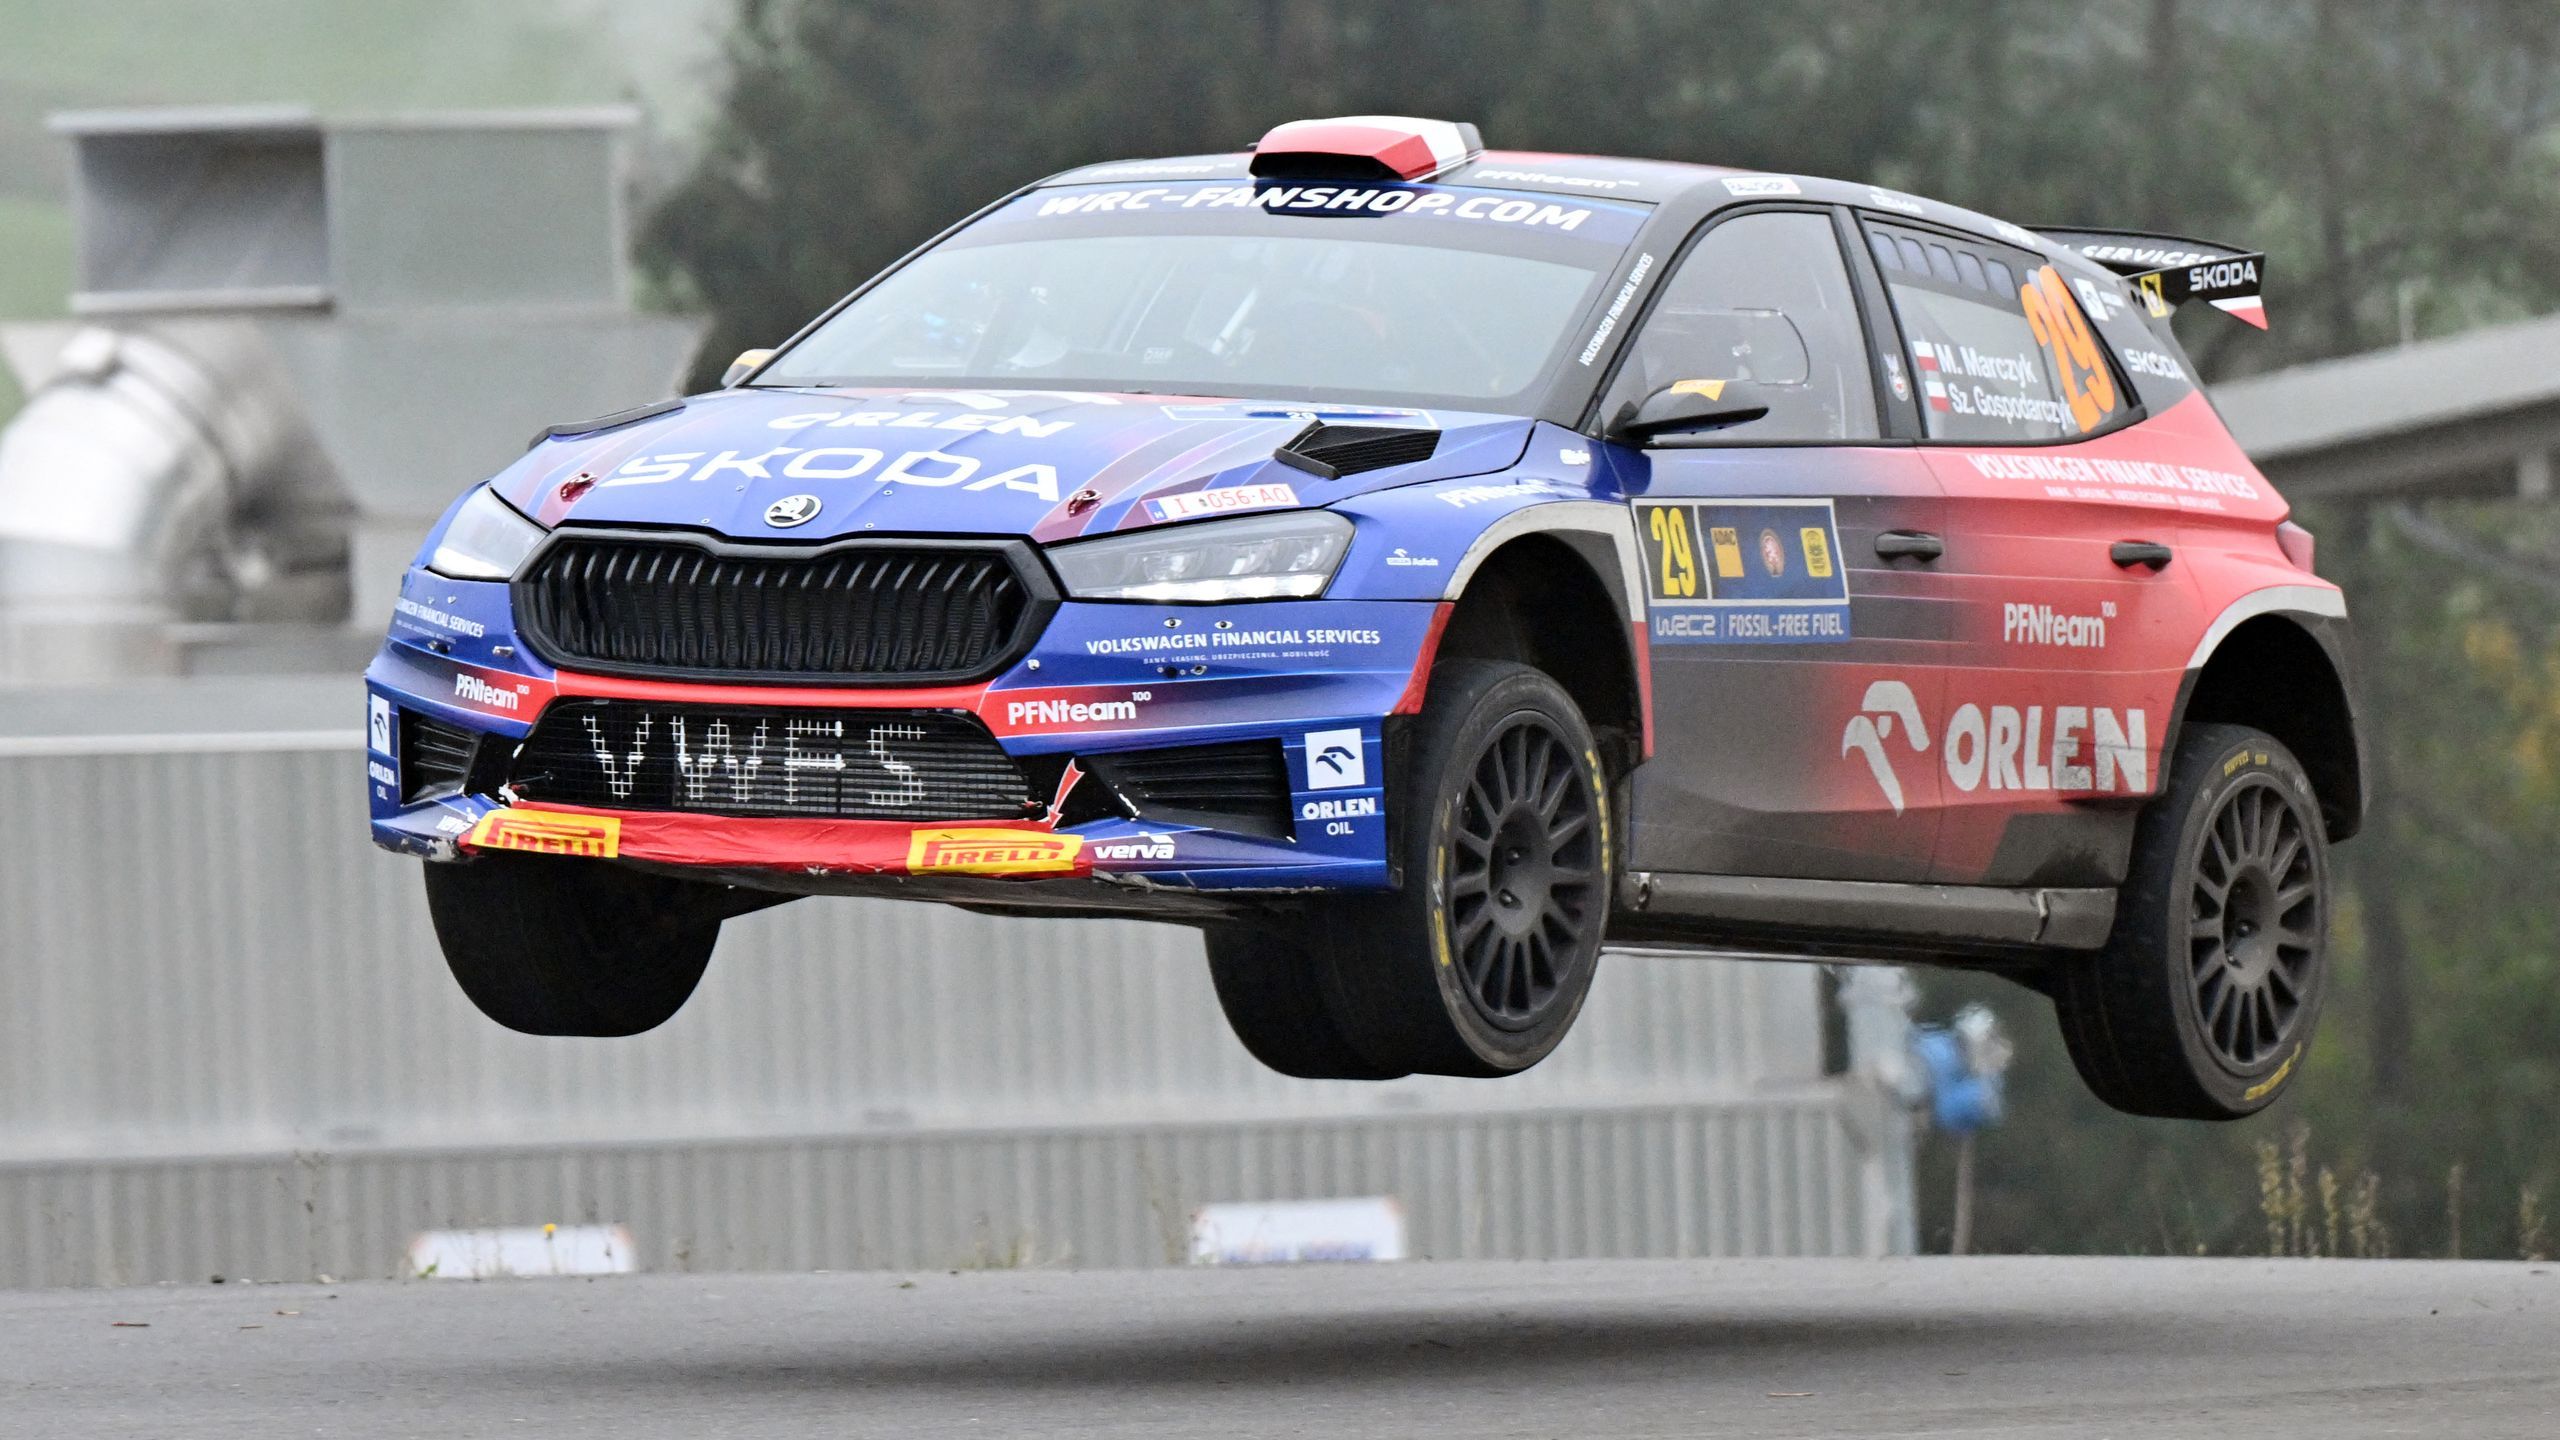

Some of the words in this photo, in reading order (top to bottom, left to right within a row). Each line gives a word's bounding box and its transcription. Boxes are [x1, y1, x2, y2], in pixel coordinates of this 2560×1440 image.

[1036, 186, 1592, 231] WRC-FANSHOP.COM
[2021, 265, 2116, 433] 29
[1934, 344, 1962, 375] M.
[1959, 346, 2038, 388] Marczyk
[1947, 383, 1976, 415] Sz.
[1973, 385, 2077, 431] Gospodarczyk
[767, 411, 1077, 439] ORLEN
[1966, 453, 2100, 483] VOLKSWAGEN
[2097, 458, 2189, 490] FINANCIAL
[2180, 465, 2260, 501] SERVICES
[1650, 506, 1697, 597] 29
[448, 615, 485, 638] SERVICES
[1728, 613, 1810, 637] FOSSIL-FREE
[1812, 613, 1845, 636] FUEL
[2003, 602, 2106, 648] PFNteam
[1086, 633, 1207, 655] VOLKSWAGEN
[1212, 630, 1303, 647] FINANCIAL
[1306, 628, 1381, 645] SERVICES
[455, 673, 518, 711] PFNteam
[1007, 696, 1137, 726] PFNteam
[1945, 703, 2148, 793] ORLEN
[368, 760, 396, 787] ORLEN
[376, 785, 389, 800] OIL
[1302, 797, 1376, 819] ORLEN
[484, 817, 607, 857] PIRELLI
[1326, 821, 1354, 836] OIL
[922, 839, 1064, 867] PIRELLI
[1094, 840, 1176, 861] verva
